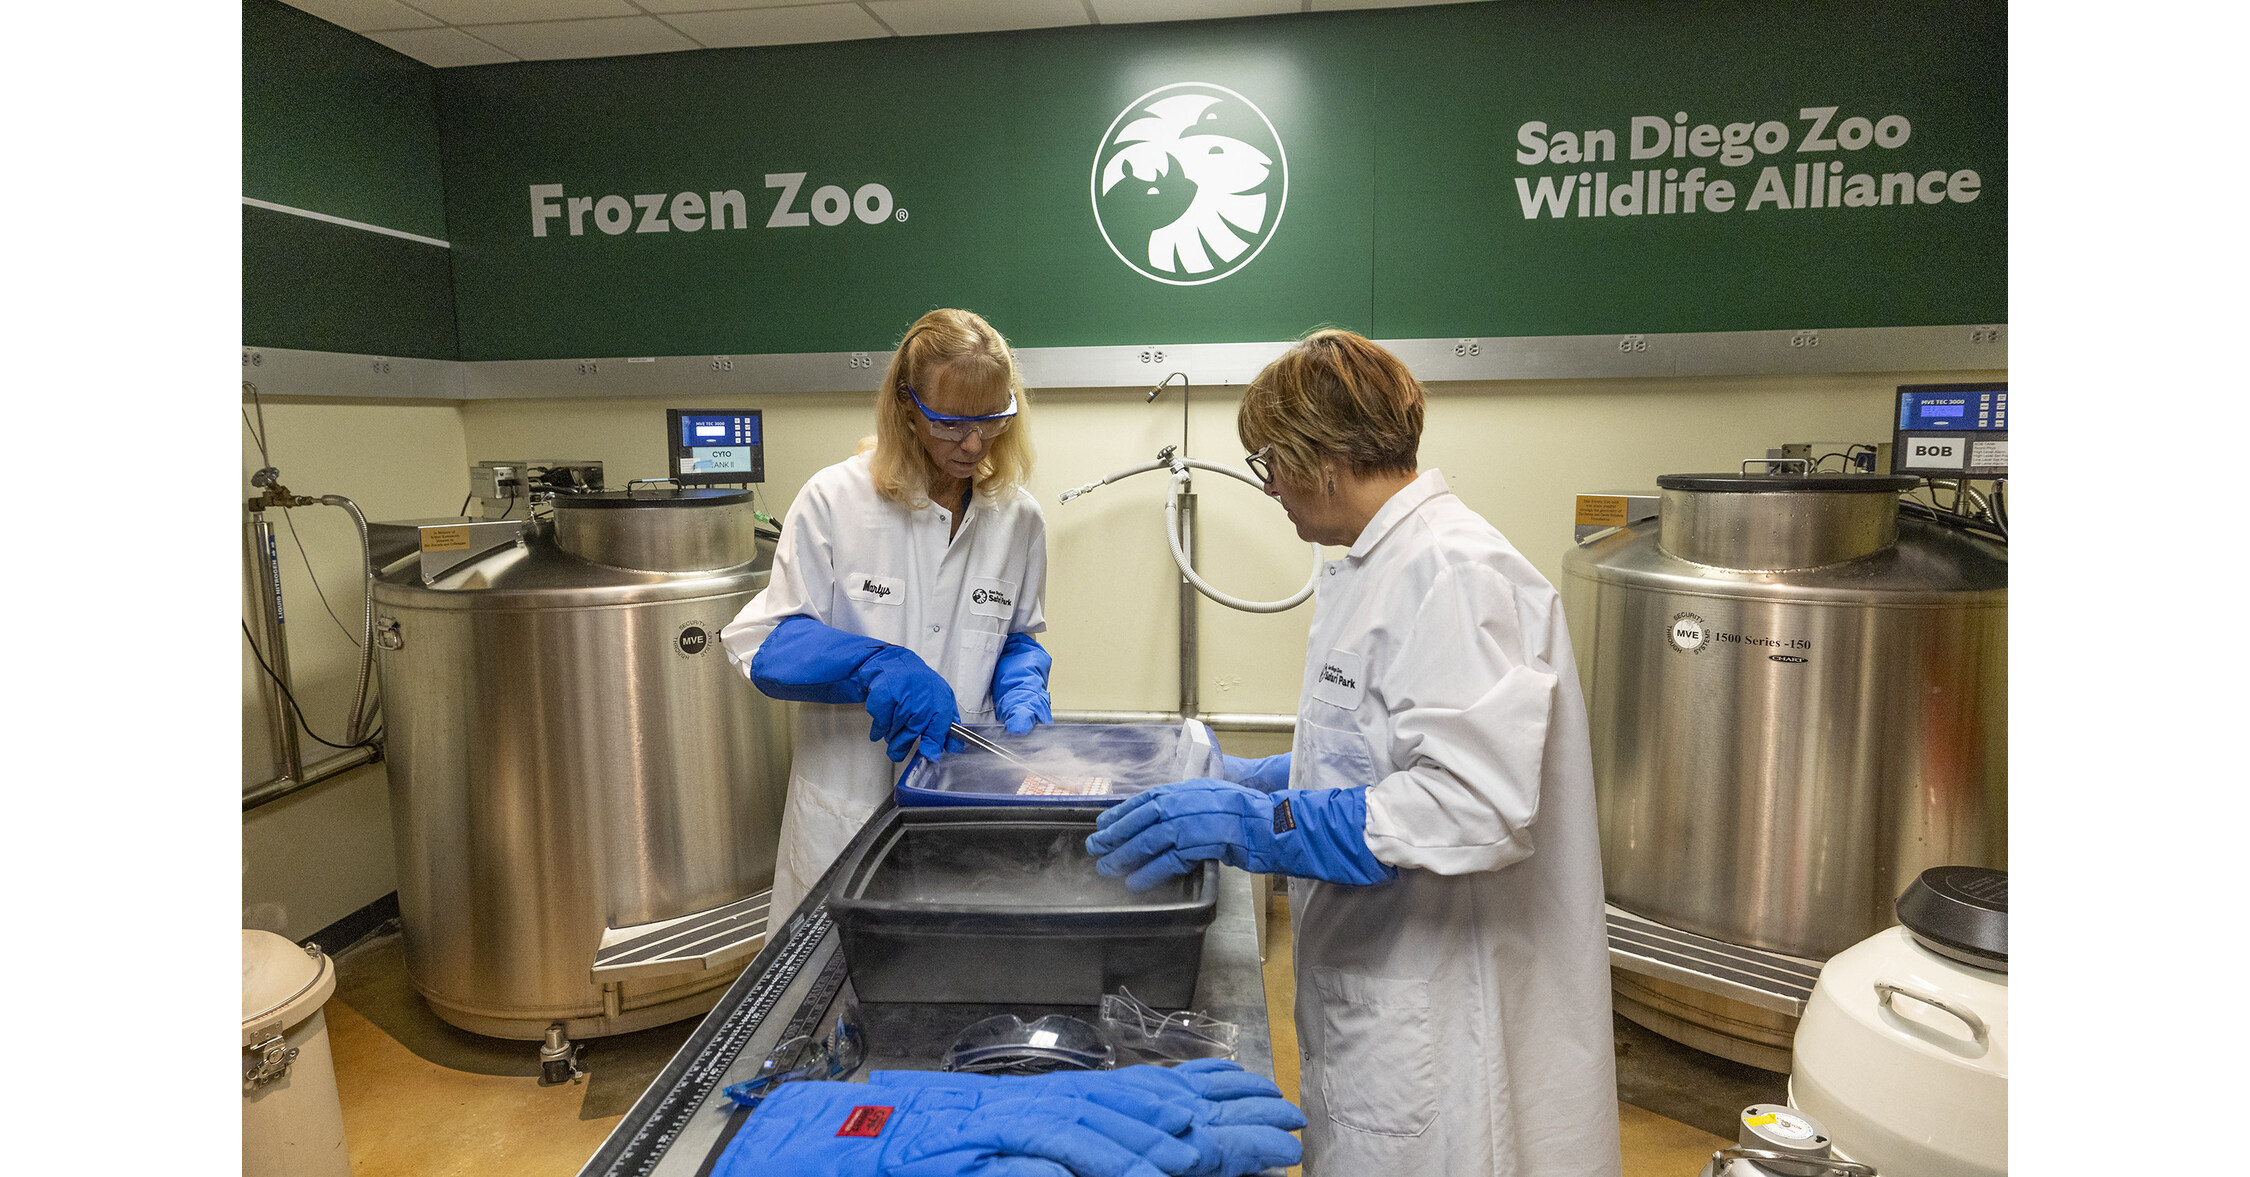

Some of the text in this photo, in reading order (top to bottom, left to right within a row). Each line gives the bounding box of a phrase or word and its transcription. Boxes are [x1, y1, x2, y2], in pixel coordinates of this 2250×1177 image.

[1515, 105, 1912, 166] San Diego Zoo
[1514, 162, 1981, 220] Wildlife Alliance
[529, 183, 748, 237] Frozen
[1916, 446, 1953, 457] BOB
[271, 560, 284, 619] LIQUID NITROGEN
[862, 579, 891, 597] Marlys
[679, 619, 705, 631] SECURITY
[1673, 611, 1705, 623] SECURITY
[682, 635, 704, 646] MVE
[700, 630, 712, 657] SYSTEMS
[1666, 625, 1683, 653] THROUGH
[1677, 630, 1699, 639] MVE
[1693, 629, 1710, 655] SYSTEMS
[1715, 632, 1811, 650] 1500 Series -150
[673, 637, 690, 660] THROUGH
[1338, 675, 1356, 689] Park
